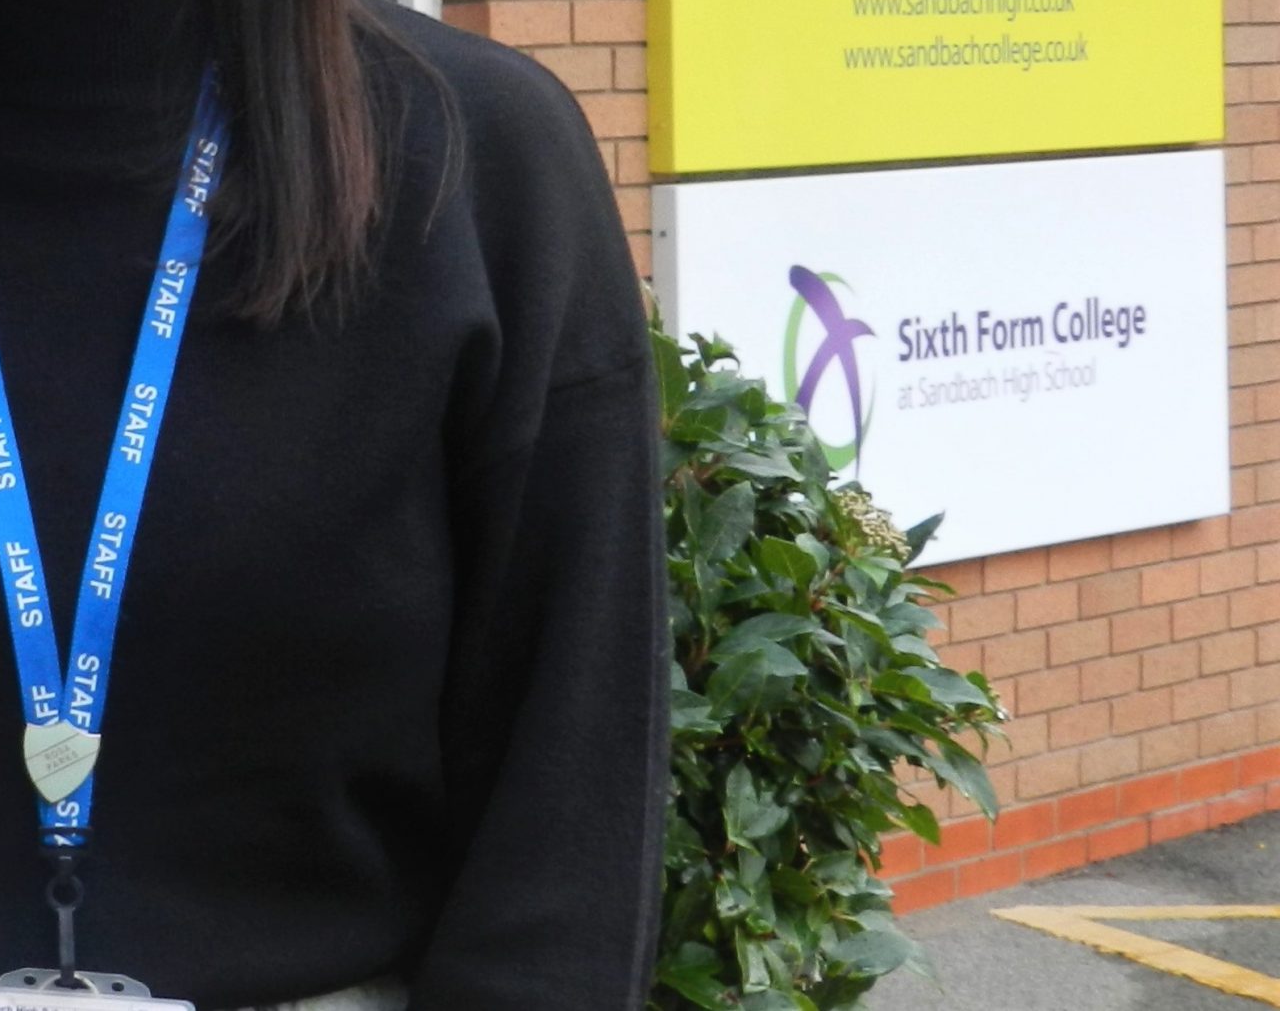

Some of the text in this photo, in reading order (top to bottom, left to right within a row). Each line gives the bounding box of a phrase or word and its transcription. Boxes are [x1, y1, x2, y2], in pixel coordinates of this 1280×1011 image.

[843, 32, 1089, 72] www.sandbachcollege.co.uk
[898, 296, 1146, 362] Sixth Form College
[896, 356, 1097, 411] at Sandbach High School
[70, 138, 218, 734] STAFF STAFF STAFF STAFF STAF
[6, 541, 43, 628] STAFF
